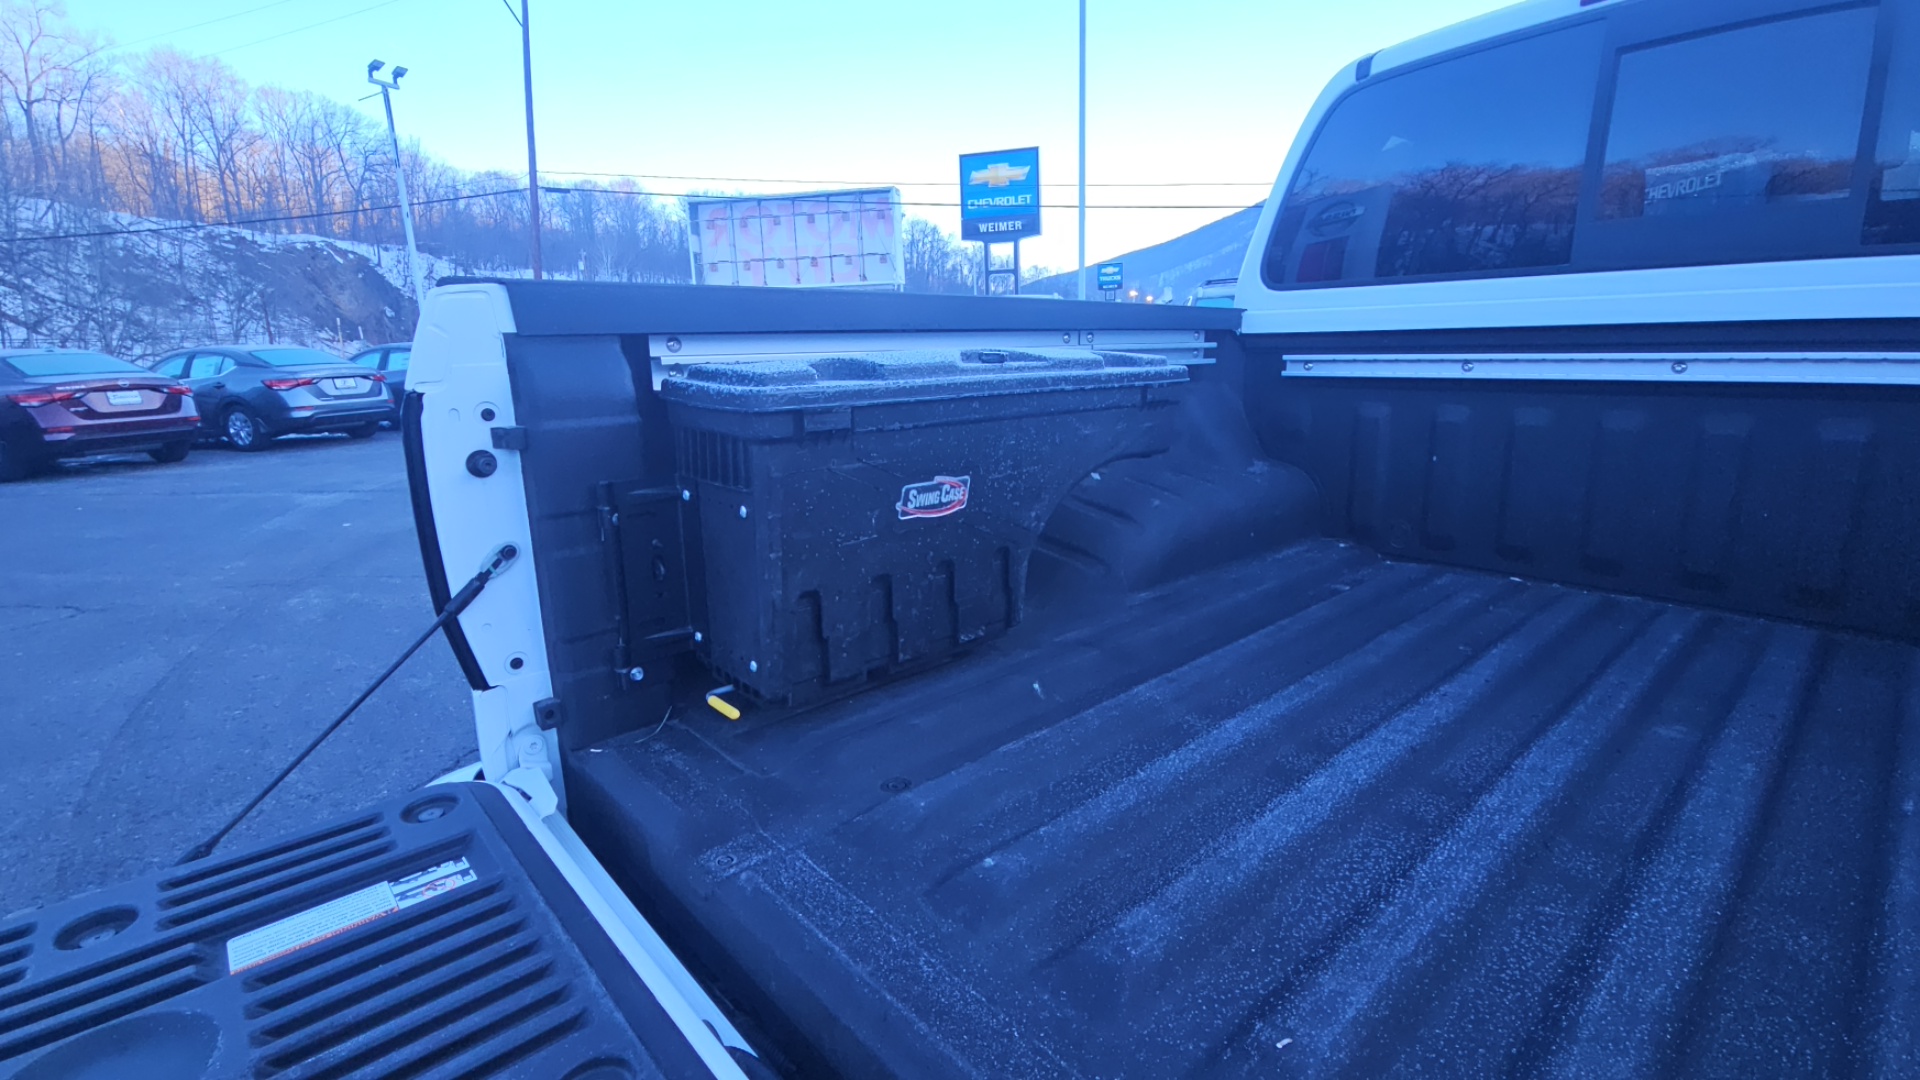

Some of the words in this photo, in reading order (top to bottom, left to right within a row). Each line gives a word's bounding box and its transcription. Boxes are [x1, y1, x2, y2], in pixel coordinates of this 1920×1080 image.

[967, 194, 1032, 209] CHEVROLET
[979, 220, 1022, 233] WEIMER
[907, 489, 941, 509] SWING
[941, 483, 966, 503] CASE
